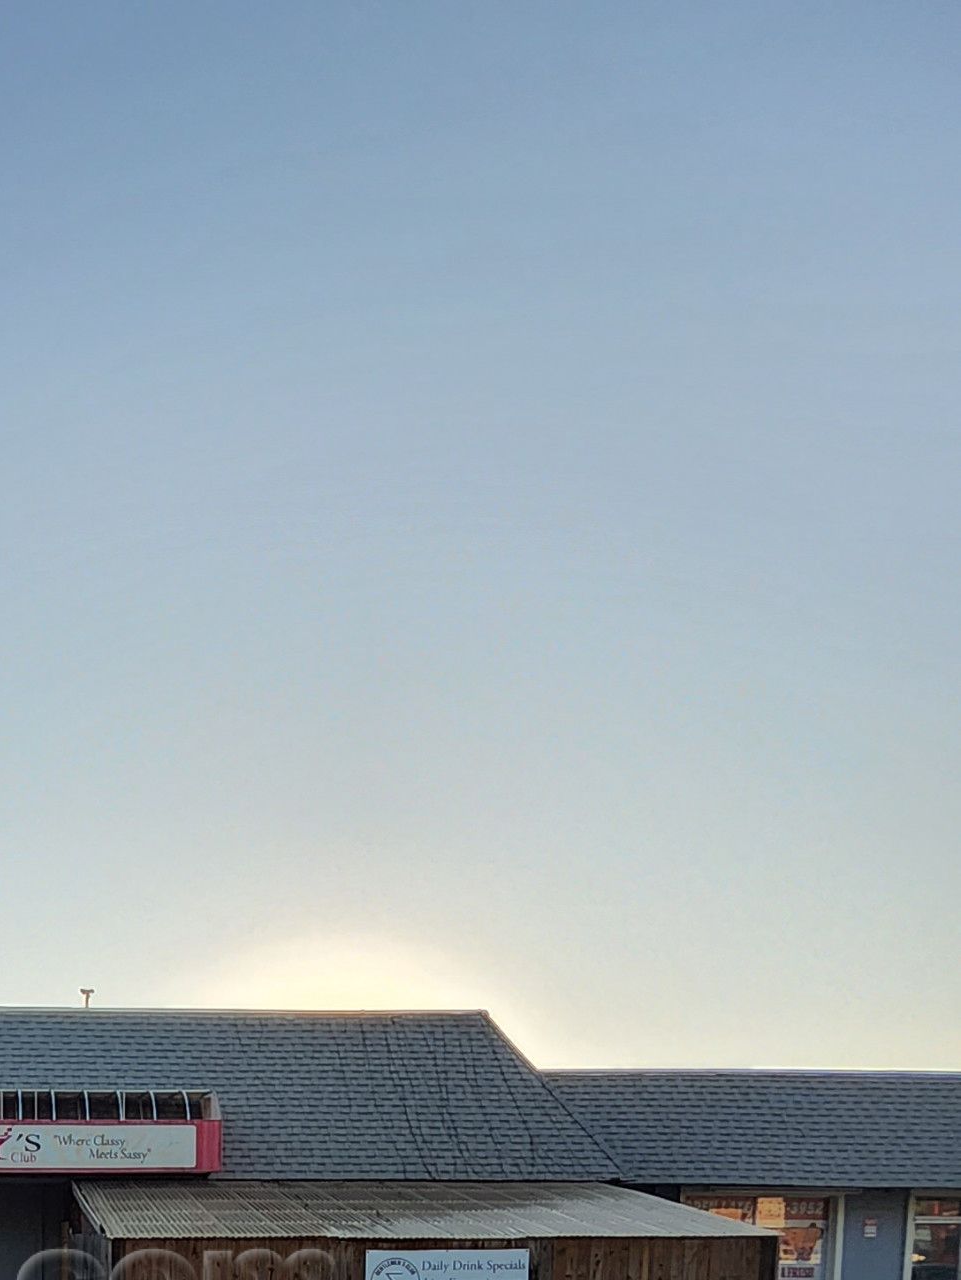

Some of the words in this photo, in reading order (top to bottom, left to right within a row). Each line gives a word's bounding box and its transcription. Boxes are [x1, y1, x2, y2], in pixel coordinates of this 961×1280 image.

[93, 1134, 126, 1149] Classy
[11, 1152, 36, 1164] Club
[89, 1147, 118, 1160] Meets
[421, 1260, 448, 1273] Daily
[452, 1259, 483, 1271] Drink
[487, 1259, 526, 1273] Specials
